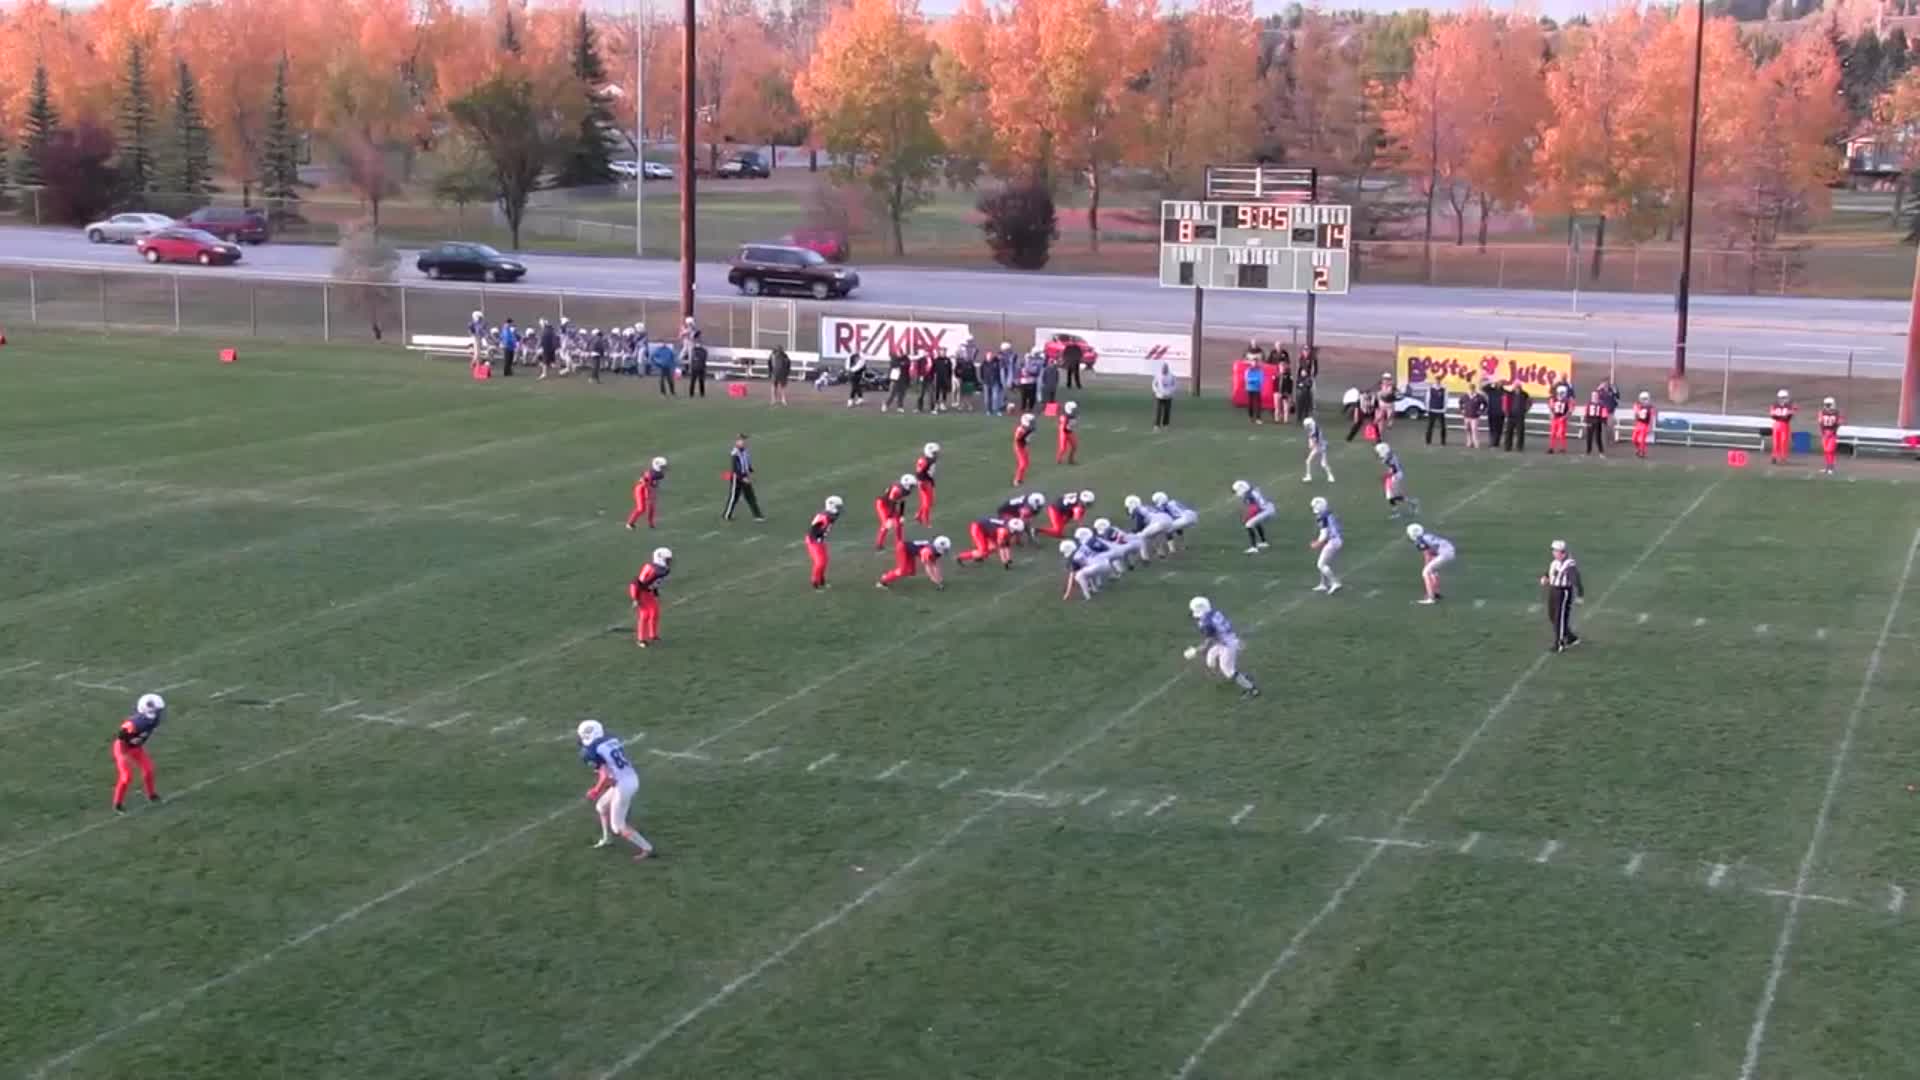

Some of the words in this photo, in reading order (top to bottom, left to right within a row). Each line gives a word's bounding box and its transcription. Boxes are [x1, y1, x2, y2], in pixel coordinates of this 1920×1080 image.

[1237, 206, 1288, 230] 9:05
[1178, 220, 1193, 242] 8
[1326, 224, 1349, 249] 14
[1314, 268, 1329, 290] 2
[834, 322, 947, 356] RE/MAX
[1503, 360, 1558, 386] Juice
